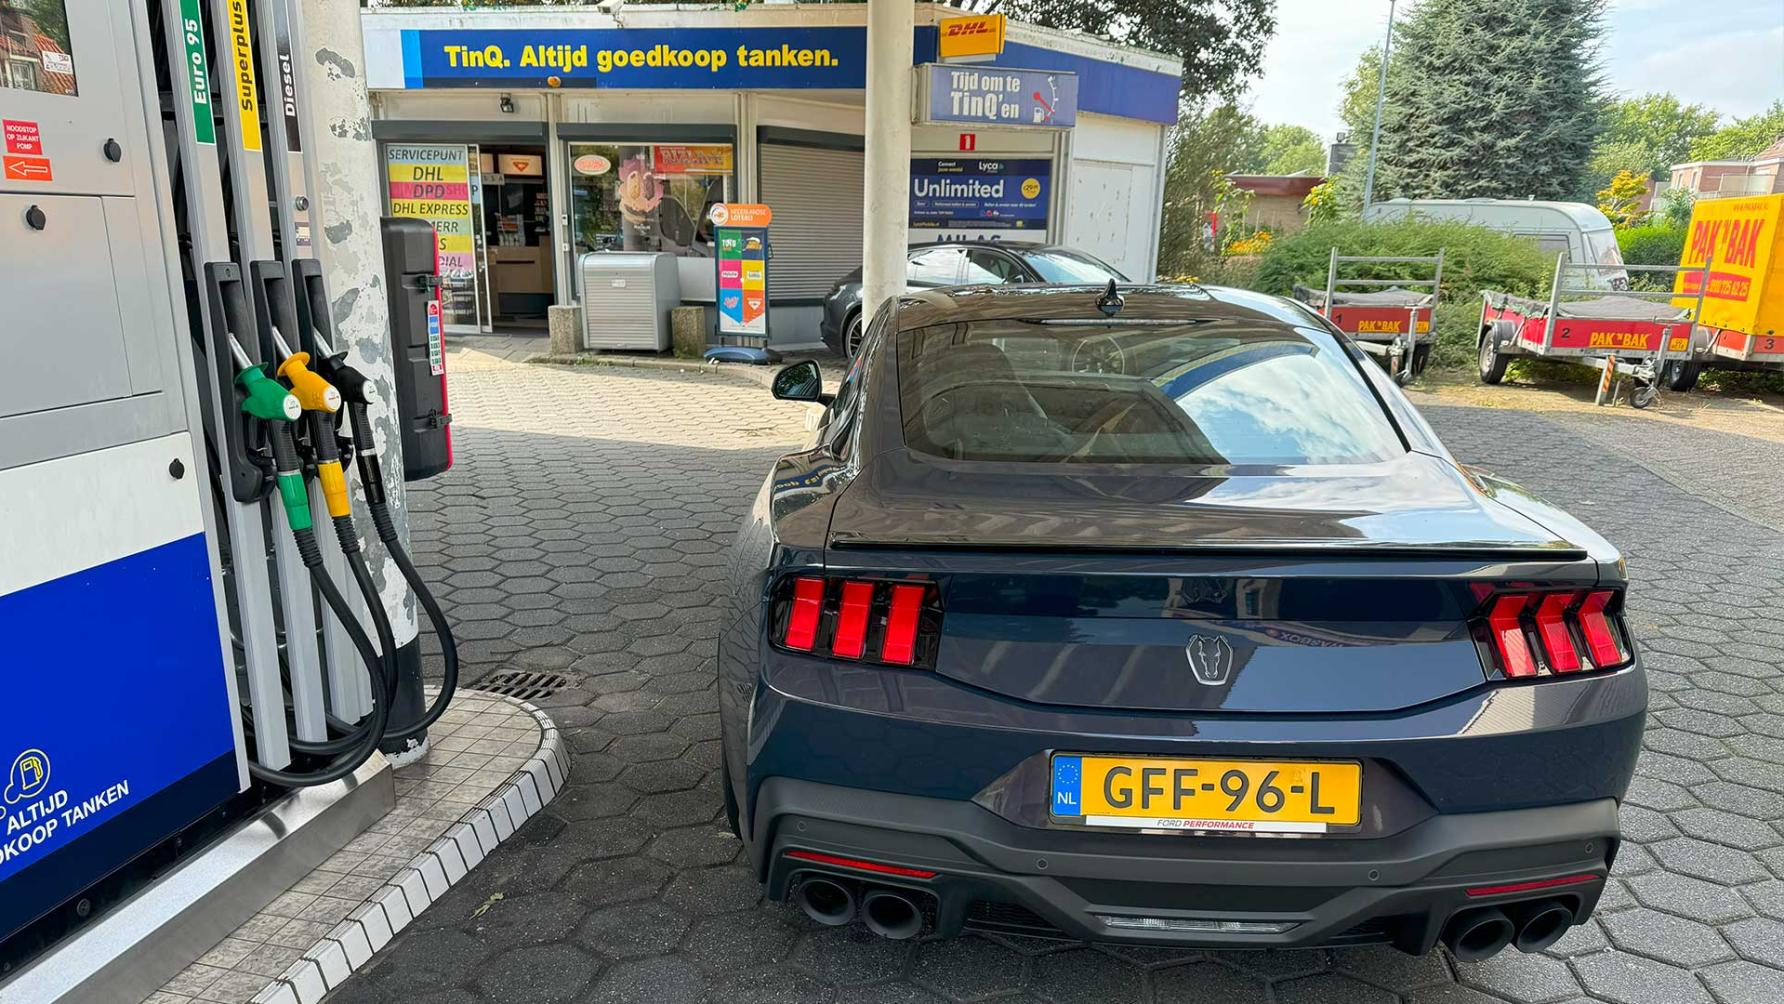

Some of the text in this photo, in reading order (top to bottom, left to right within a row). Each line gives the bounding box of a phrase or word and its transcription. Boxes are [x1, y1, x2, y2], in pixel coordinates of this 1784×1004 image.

[948, 21, 988, 36] DHL
[185, 18, 207, 104] Euro 95
[233, 0, 253, 112] Superplus
[443, 44, 839, 73] TinQ. Altijd goedkoop tanken.
[279, 53, 296, 117] Diesel
[951, 71, 1020, 92] Tijd om te
[950, 91, 1019, 120] TinQ'en
[389, 149, 463, 161] SERVICEPUNT
[413, 166, 444, 181] DHL
[978, 161, 999, 172] Lyca
[413, 184, 446, 199] DPD
[914, 178, 1005, 198] Unlimited
[393, 202, 469, 216] DHL EXPRESS
[1688, 219, 1723, 265] PAK
[1724, 218, 1765, 269] BAK
[1335, 314, 1342, 324] 1
[1358, 320, 1377, 331] PAK
[1382, 320, 1401, 331] BAK
[1561, 327, 1570, 339] 2
[1590, 332, 1618, 346] PAK
[1622, 333, 1649, 347] BAK
[1764, 338, 1774, 350] 3
[1103, 765, 1335, 815] GFF-96-L
[1057, 791, 1077, 805] NL
[6, 789, 68, 835] ALTIJD
[0, 779, 130, 865] KOOP TANKEN
[1157, 819, 1255, 830] FORD PERFORMANCE
